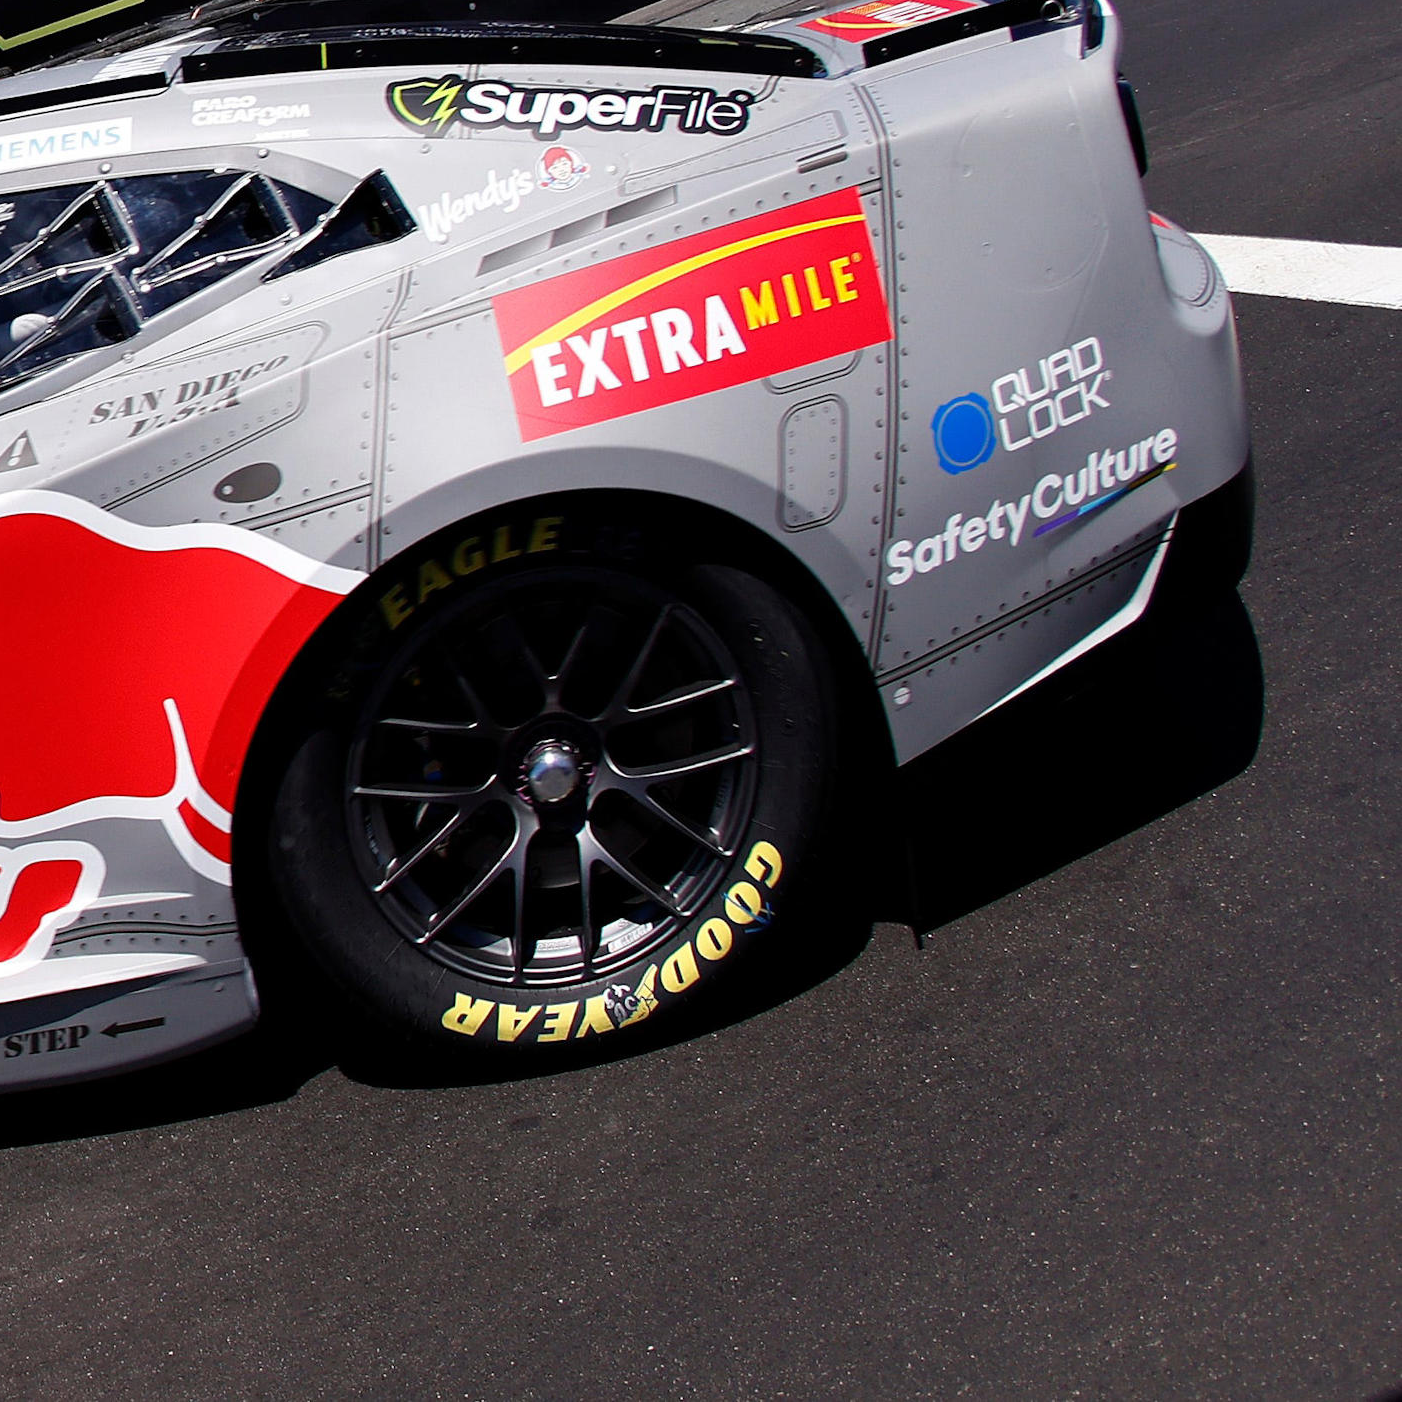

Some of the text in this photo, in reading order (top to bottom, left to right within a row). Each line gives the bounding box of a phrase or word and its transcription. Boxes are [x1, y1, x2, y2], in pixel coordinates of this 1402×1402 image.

[192, 95, 257, 113] FARO
[192, 103, 311, 126] CREAFORM
[460, 83, 744, 134] SuperFile
[416, 169, 535, 243] Wendy's
[88, 355, 289, 425] SAN DIEGO
[991, 336, 1104, 414] QUAD
[886, 427, 1178, 586] SafetyCulture
[378, 516, 564, 630] EAGLE
[4, 1024, 91, 1059] STEP
